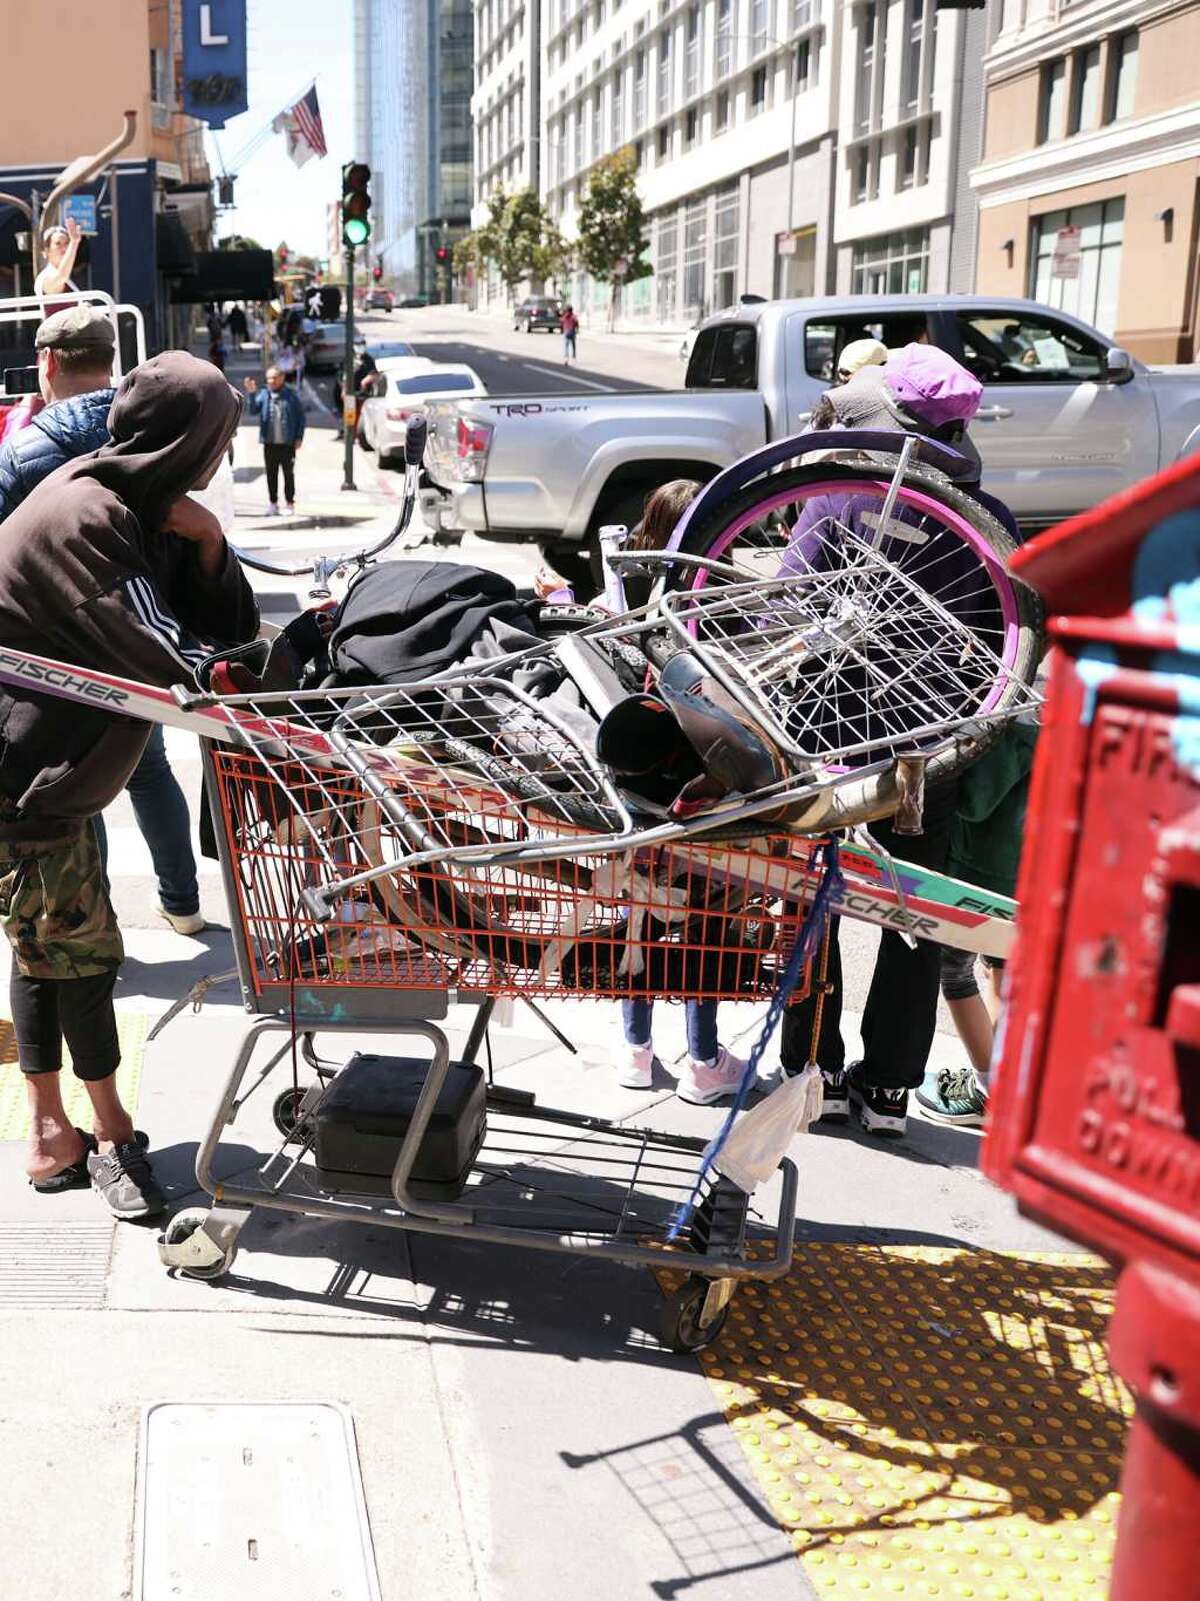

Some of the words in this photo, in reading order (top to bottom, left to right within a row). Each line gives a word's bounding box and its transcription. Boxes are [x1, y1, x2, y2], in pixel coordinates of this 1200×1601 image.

[201, 4, 229, 46] L
[490, 403, 543, 418] TRD
[792, 878, 940, 935] FCHER
